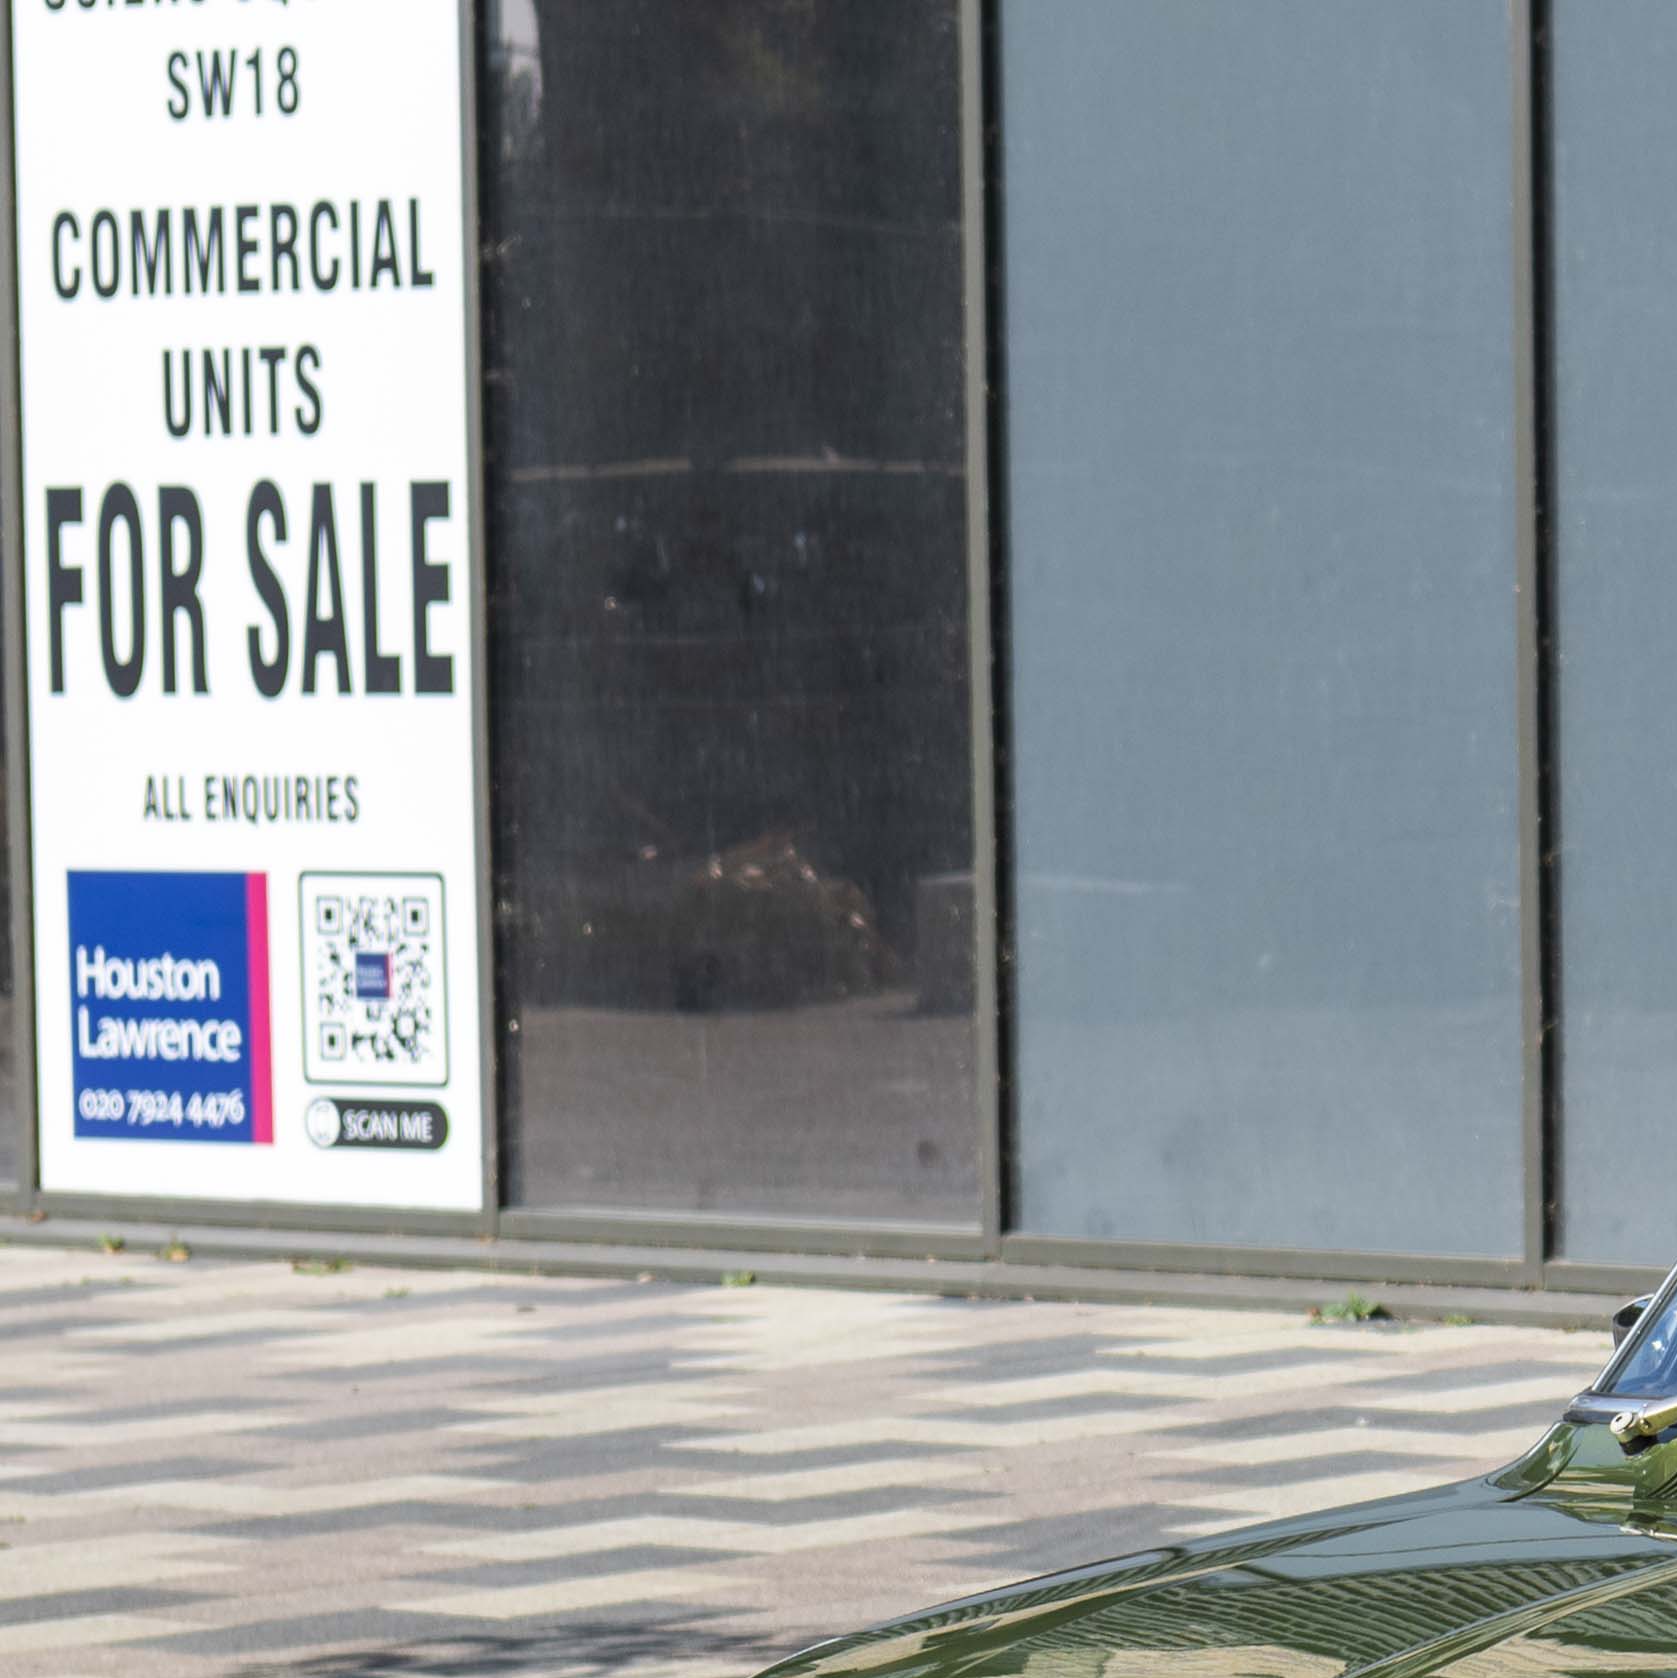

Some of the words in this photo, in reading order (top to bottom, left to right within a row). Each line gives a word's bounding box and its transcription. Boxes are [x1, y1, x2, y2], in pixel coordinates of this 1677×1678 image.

[168, 47, 299, 120] SW18
[53, 198, 433, 300] COMMERCIAL
[163, 345, 321, 438] UNITS
[46, 482, 209, 698] FOR
[247, 479, 455, 698] SALE
[144, 776, 191, 820] ALL
[205, 776, 359, 824] ENQUIRIES
[76, 946, 220, 1001] Houston
[78, 1005, 241, 1062] Lawrence
[79, 1088, 126, 1121] 020
[127, 1090, 185, 1126] 7924
[187, 1089, 246, 1127] 4476
[343, 1108, 398, 1141] SCAN
[400, 1111, 433, 1143] ME
